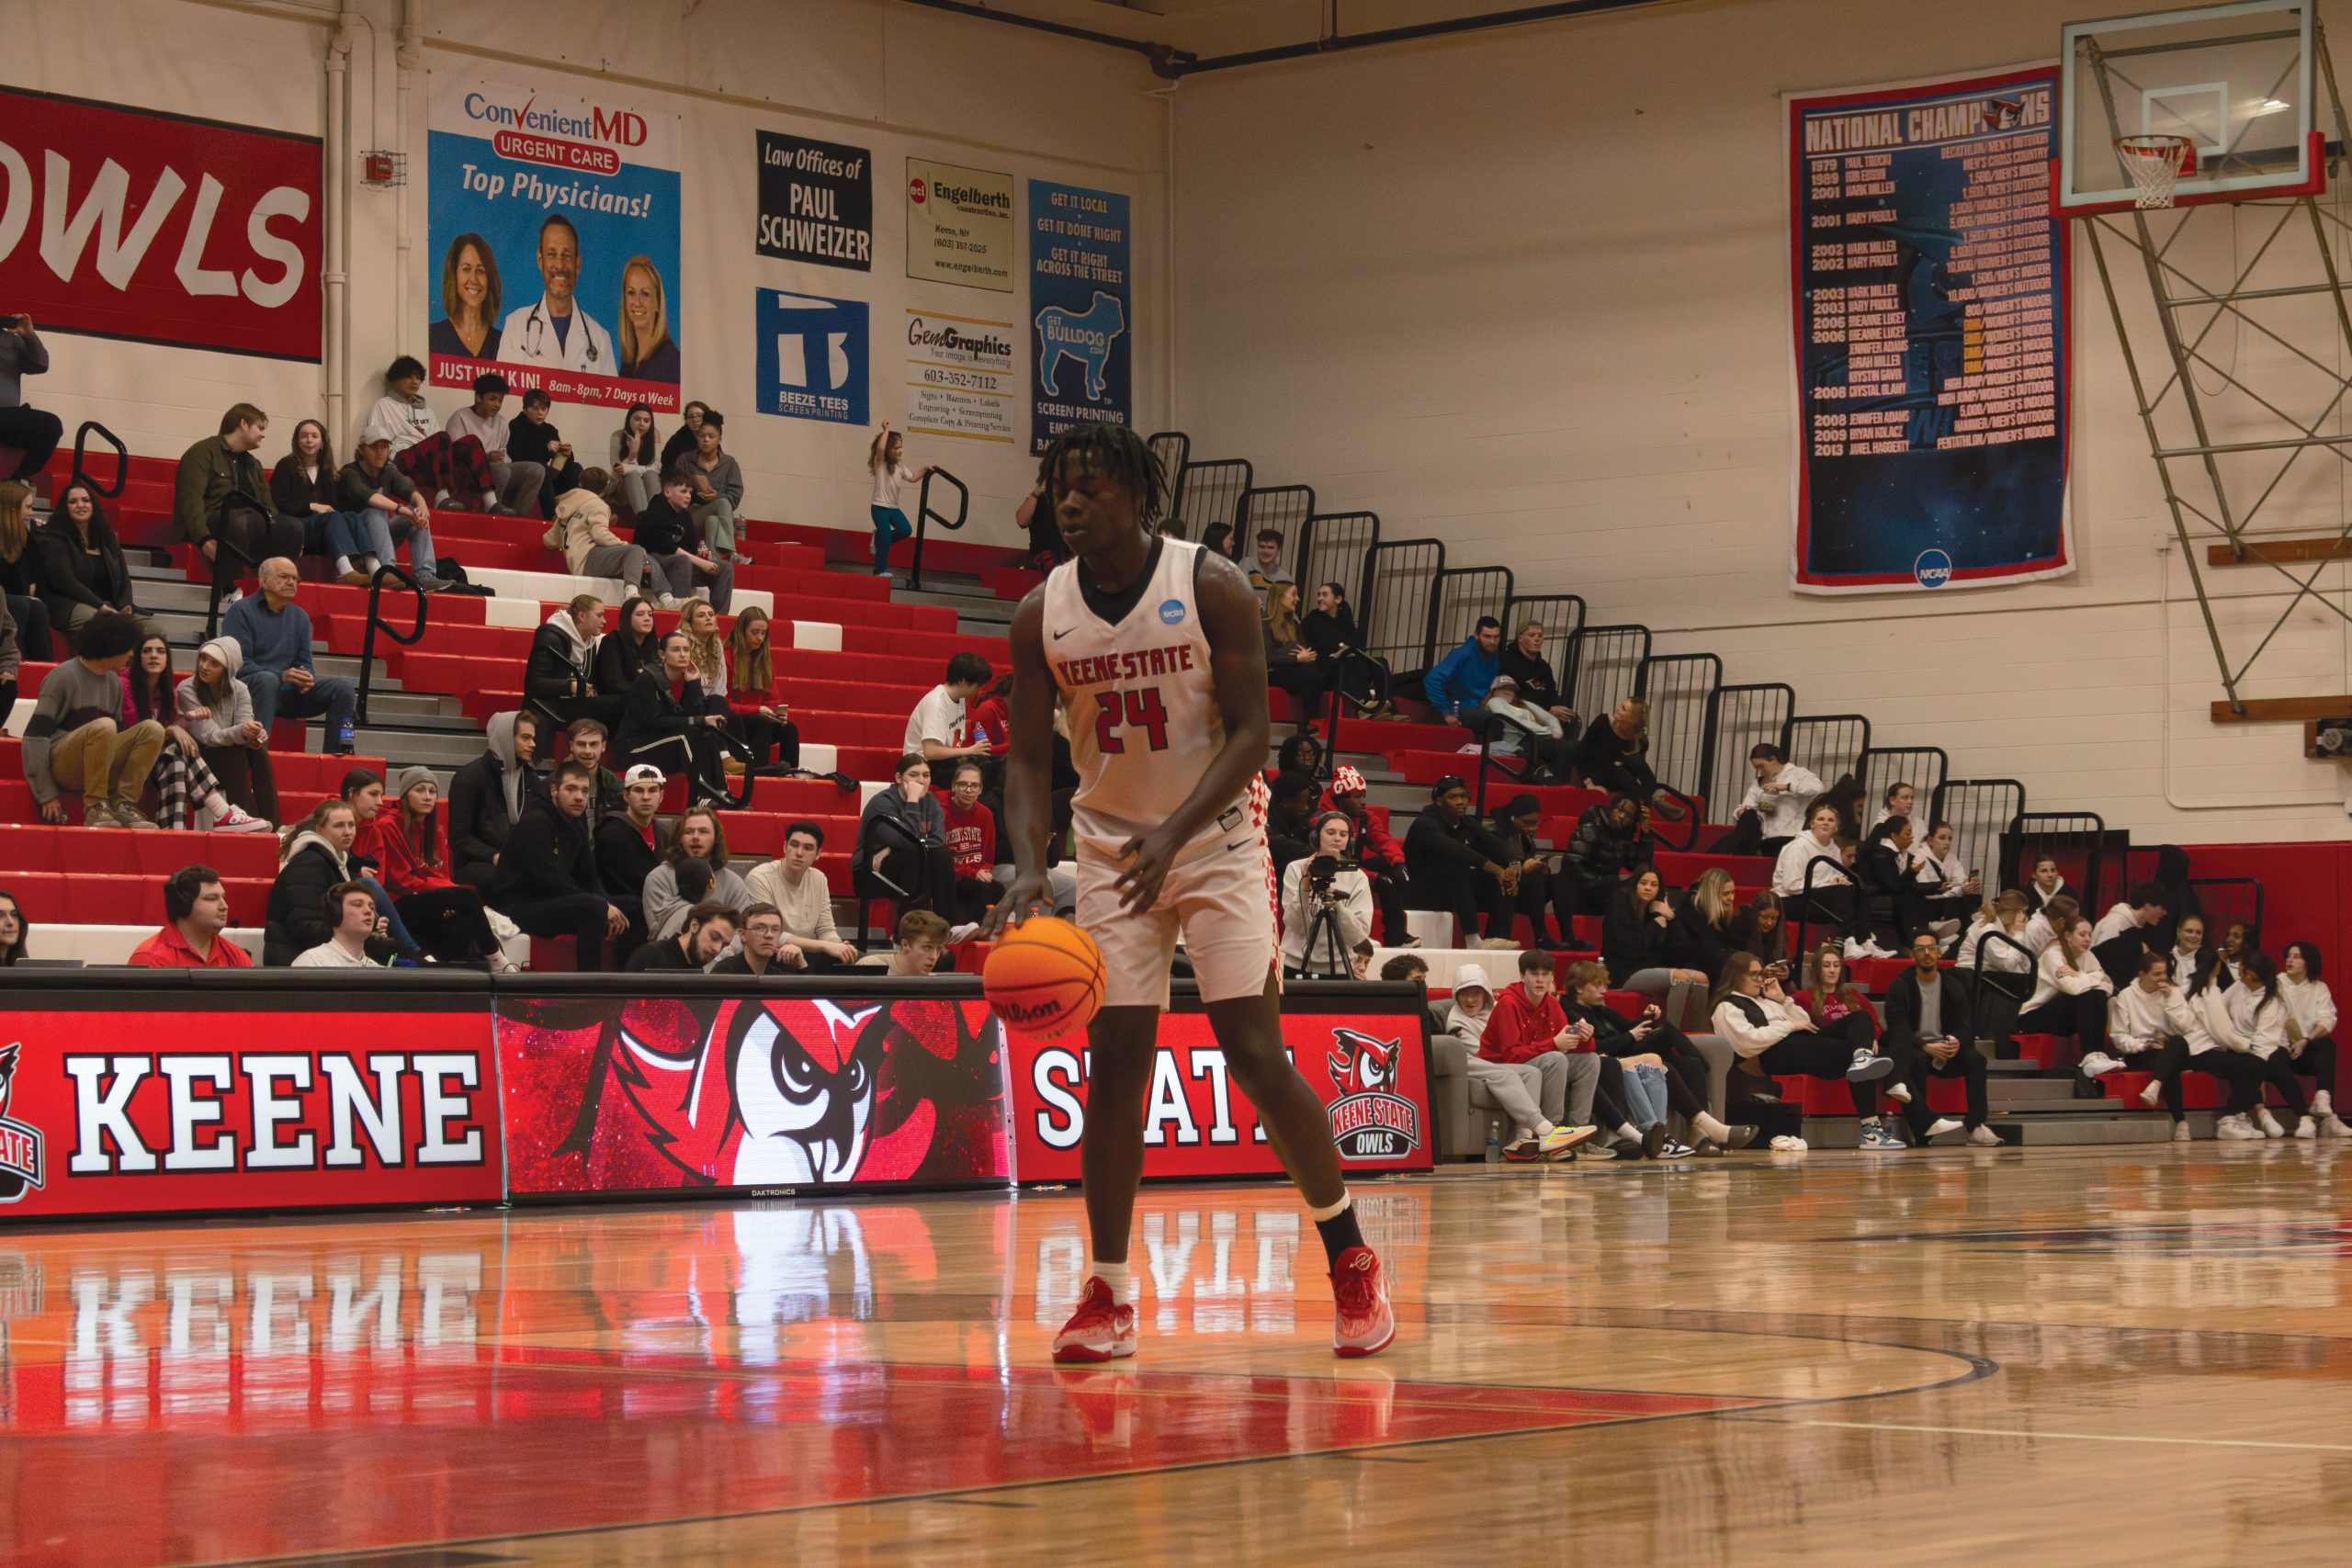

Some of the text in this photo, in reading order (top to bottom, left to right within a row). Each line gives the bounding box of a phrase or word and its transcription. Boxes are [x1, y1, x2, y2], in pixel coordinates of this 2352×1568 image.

[464, 93, 648, 147] ConvenientMD
[1805, 112, 1903, 152] NATIONAL
[1908, 91, 2050, 141] CHAMPINS
[500, 135, 614, 170] URGENT CARE
[764, 142, 863, 180] Law Offices of
[1811, 159, 1838, 173] 1979
[462, 164, 651, 218] Top Physicians!
[934, 181, 1011, 209] Engelberth
[1812, 186, 1840, 200] 2001
[790, 183, 840, 221] PAUL
[1051, 191, 1108, 214] GET IT LOCAL
[935, 224, 969, 238] Keene, NH
[1037, 217, 1122, 243] GET IT DONE RIGHT
[1812, 214, 1841, 228] 2001
[759, 213, 870, 262] SCHWEIZER
[934, 238, 955, 251] (603)
[1051, 247, 1108, 268] GET IT RIGHT
[1812, 243, 1844, 257] 2002
[934, 260, 1008, 277] www.engelberth.com
[1036, 259, 1123, 284] ACROSS THE STREET
[1812, 257, 1844, 271] 2002
[1813, 288, 1845, 301] 2003
[1813, 301, 1845, 315] 2003
[1047, 316, 1061, 326] GET
[1047, 326, 1105, 346] BULLDOG
[437, 362, 541, 389] JUST WK IN!
[924, 369, 997, 389] 603-352-7112
[548, 380, 674, 407] 8am-8pm, 7 Days a Week
[779, 390, 849, 411] BEEZE TEES
[778, 403, 849, 420] SCREEN PRINTING
[919, 401, 950, 415] Engraving
[1036, 402, 1124, 423] SCREEN PRINTING
[909, 412, 939, 425] Complete
[940, 417, 955, 428] Copy
[956, 419, 963, 427] &
[965, 420, 990, 432] Printing
[1814, 413, 1847, 427] 2008
[1849, 412, 1883, 425] JENNIFER
[1815, 429, 1848, 442] 2009
[1815, 444, 1844, 457] 2013
[1094, 686, 1169, 754] 24
[990, 999, 1062, 1022] Wilson
[1032, 1046, 1296, 1150] SAT
[62, 1050, 486, 1178] KEENE
[1332, 1098, 1415, 1139] KEENE STATE
[1356, 1133, 1394, 1154] OWLS
[752, 1189, 796, 1197] DAKTRONICS
